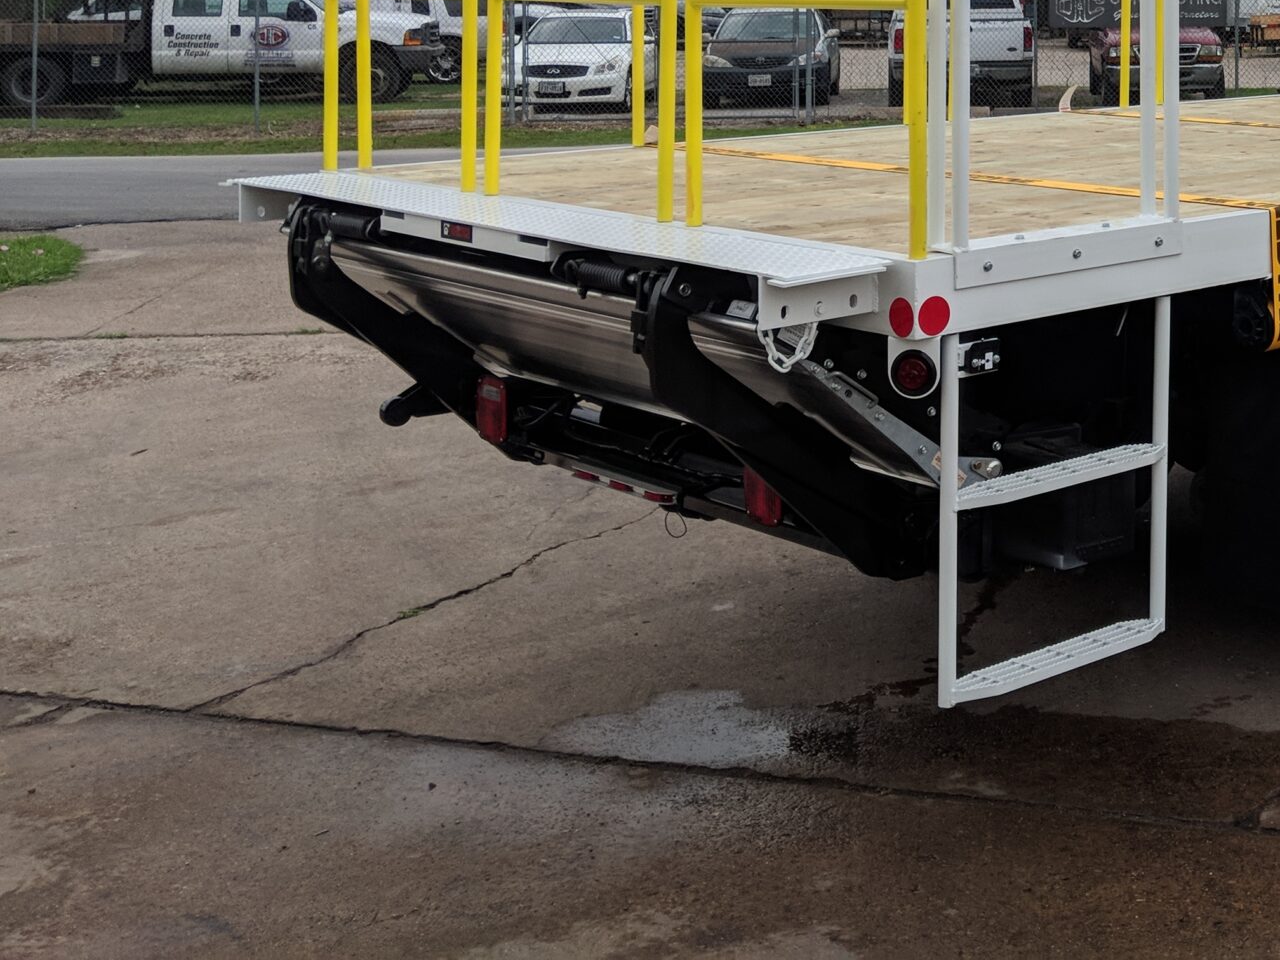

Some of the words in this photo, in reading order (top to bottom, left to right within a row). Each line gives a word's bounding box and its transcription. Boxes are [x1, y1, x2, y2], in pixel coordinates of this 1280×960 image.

[175, 32, 211, 40] Concrete
[175, 49, 181, 57] &
[184, 49, 210, 58] Repair
